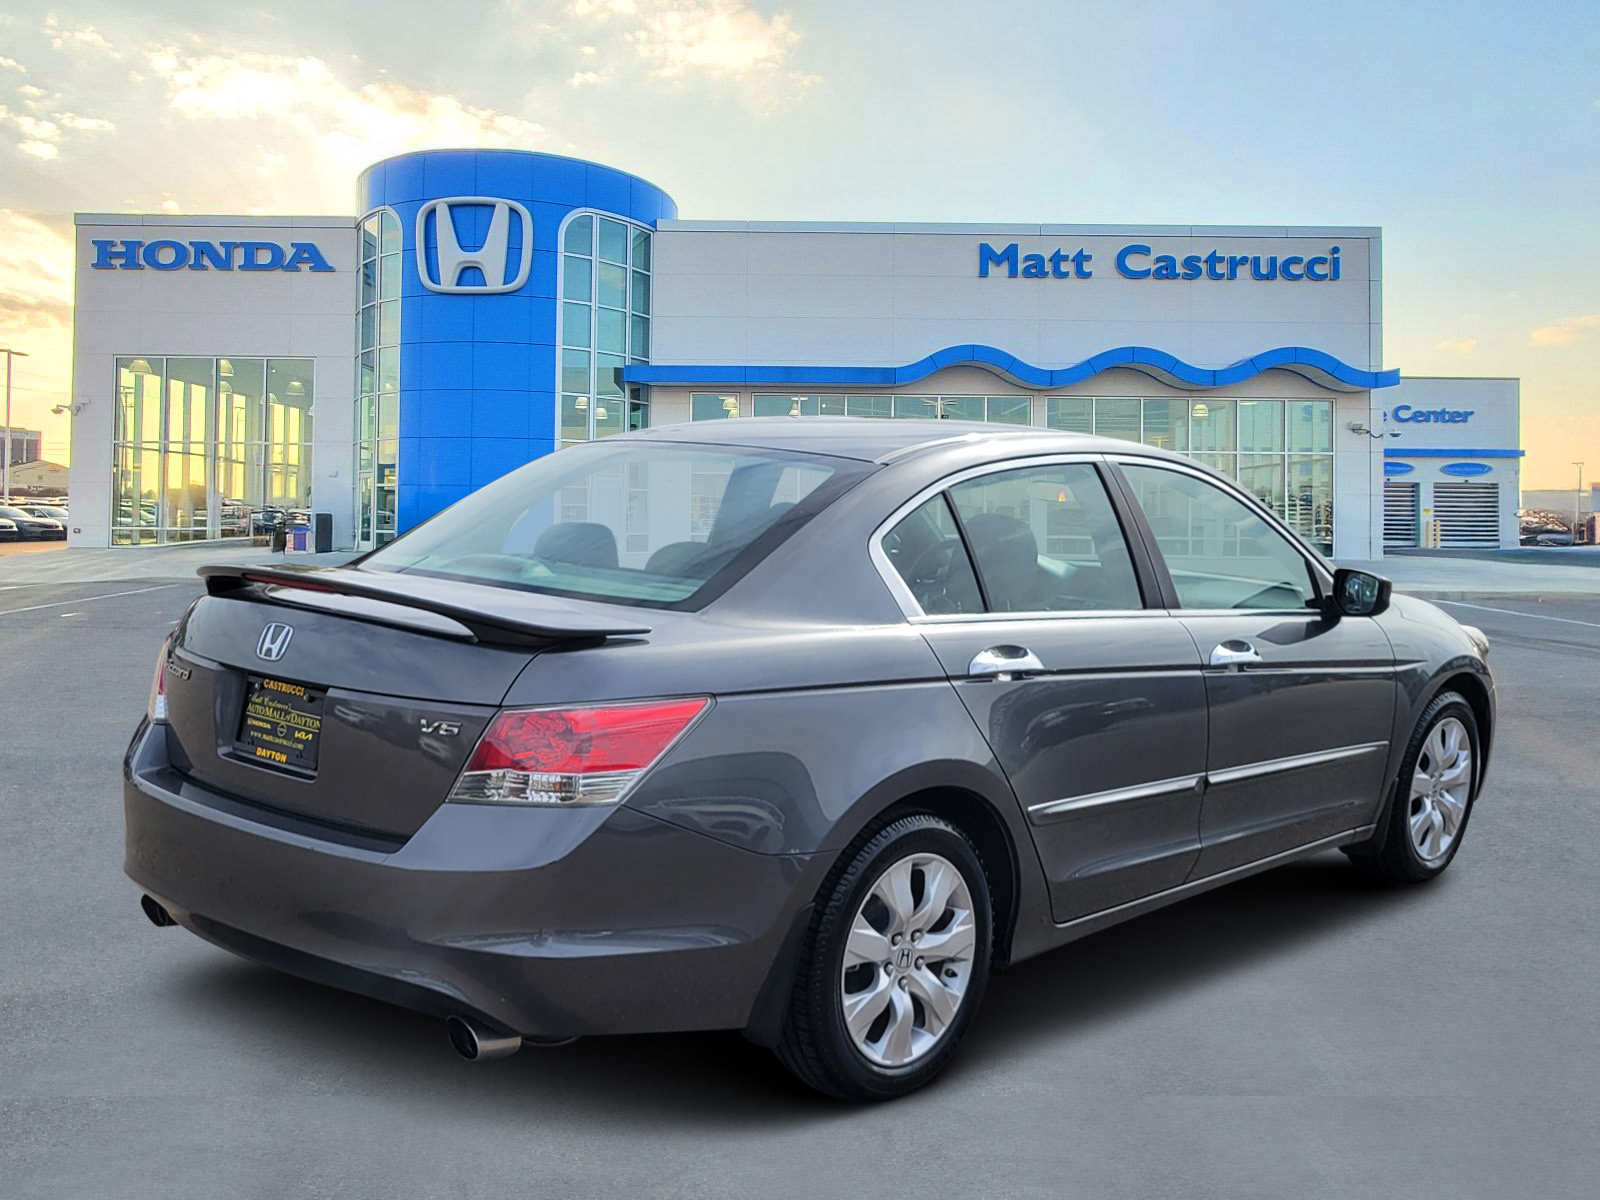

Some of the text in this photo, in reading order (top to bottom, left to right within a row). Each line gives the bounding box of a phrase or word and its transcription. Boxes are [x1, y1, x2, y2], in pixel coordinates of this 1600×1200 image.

[91, 239, 336, 272] HONDA
[978, 242, 1342, 281] Matt Castrucci
[1392, 405, 1475, 424] Center
[263, 679, 305, 697] CASTRUCCI
[420, 718, 461, 735] V6
[256, 746, 287, 763] DAYTON
